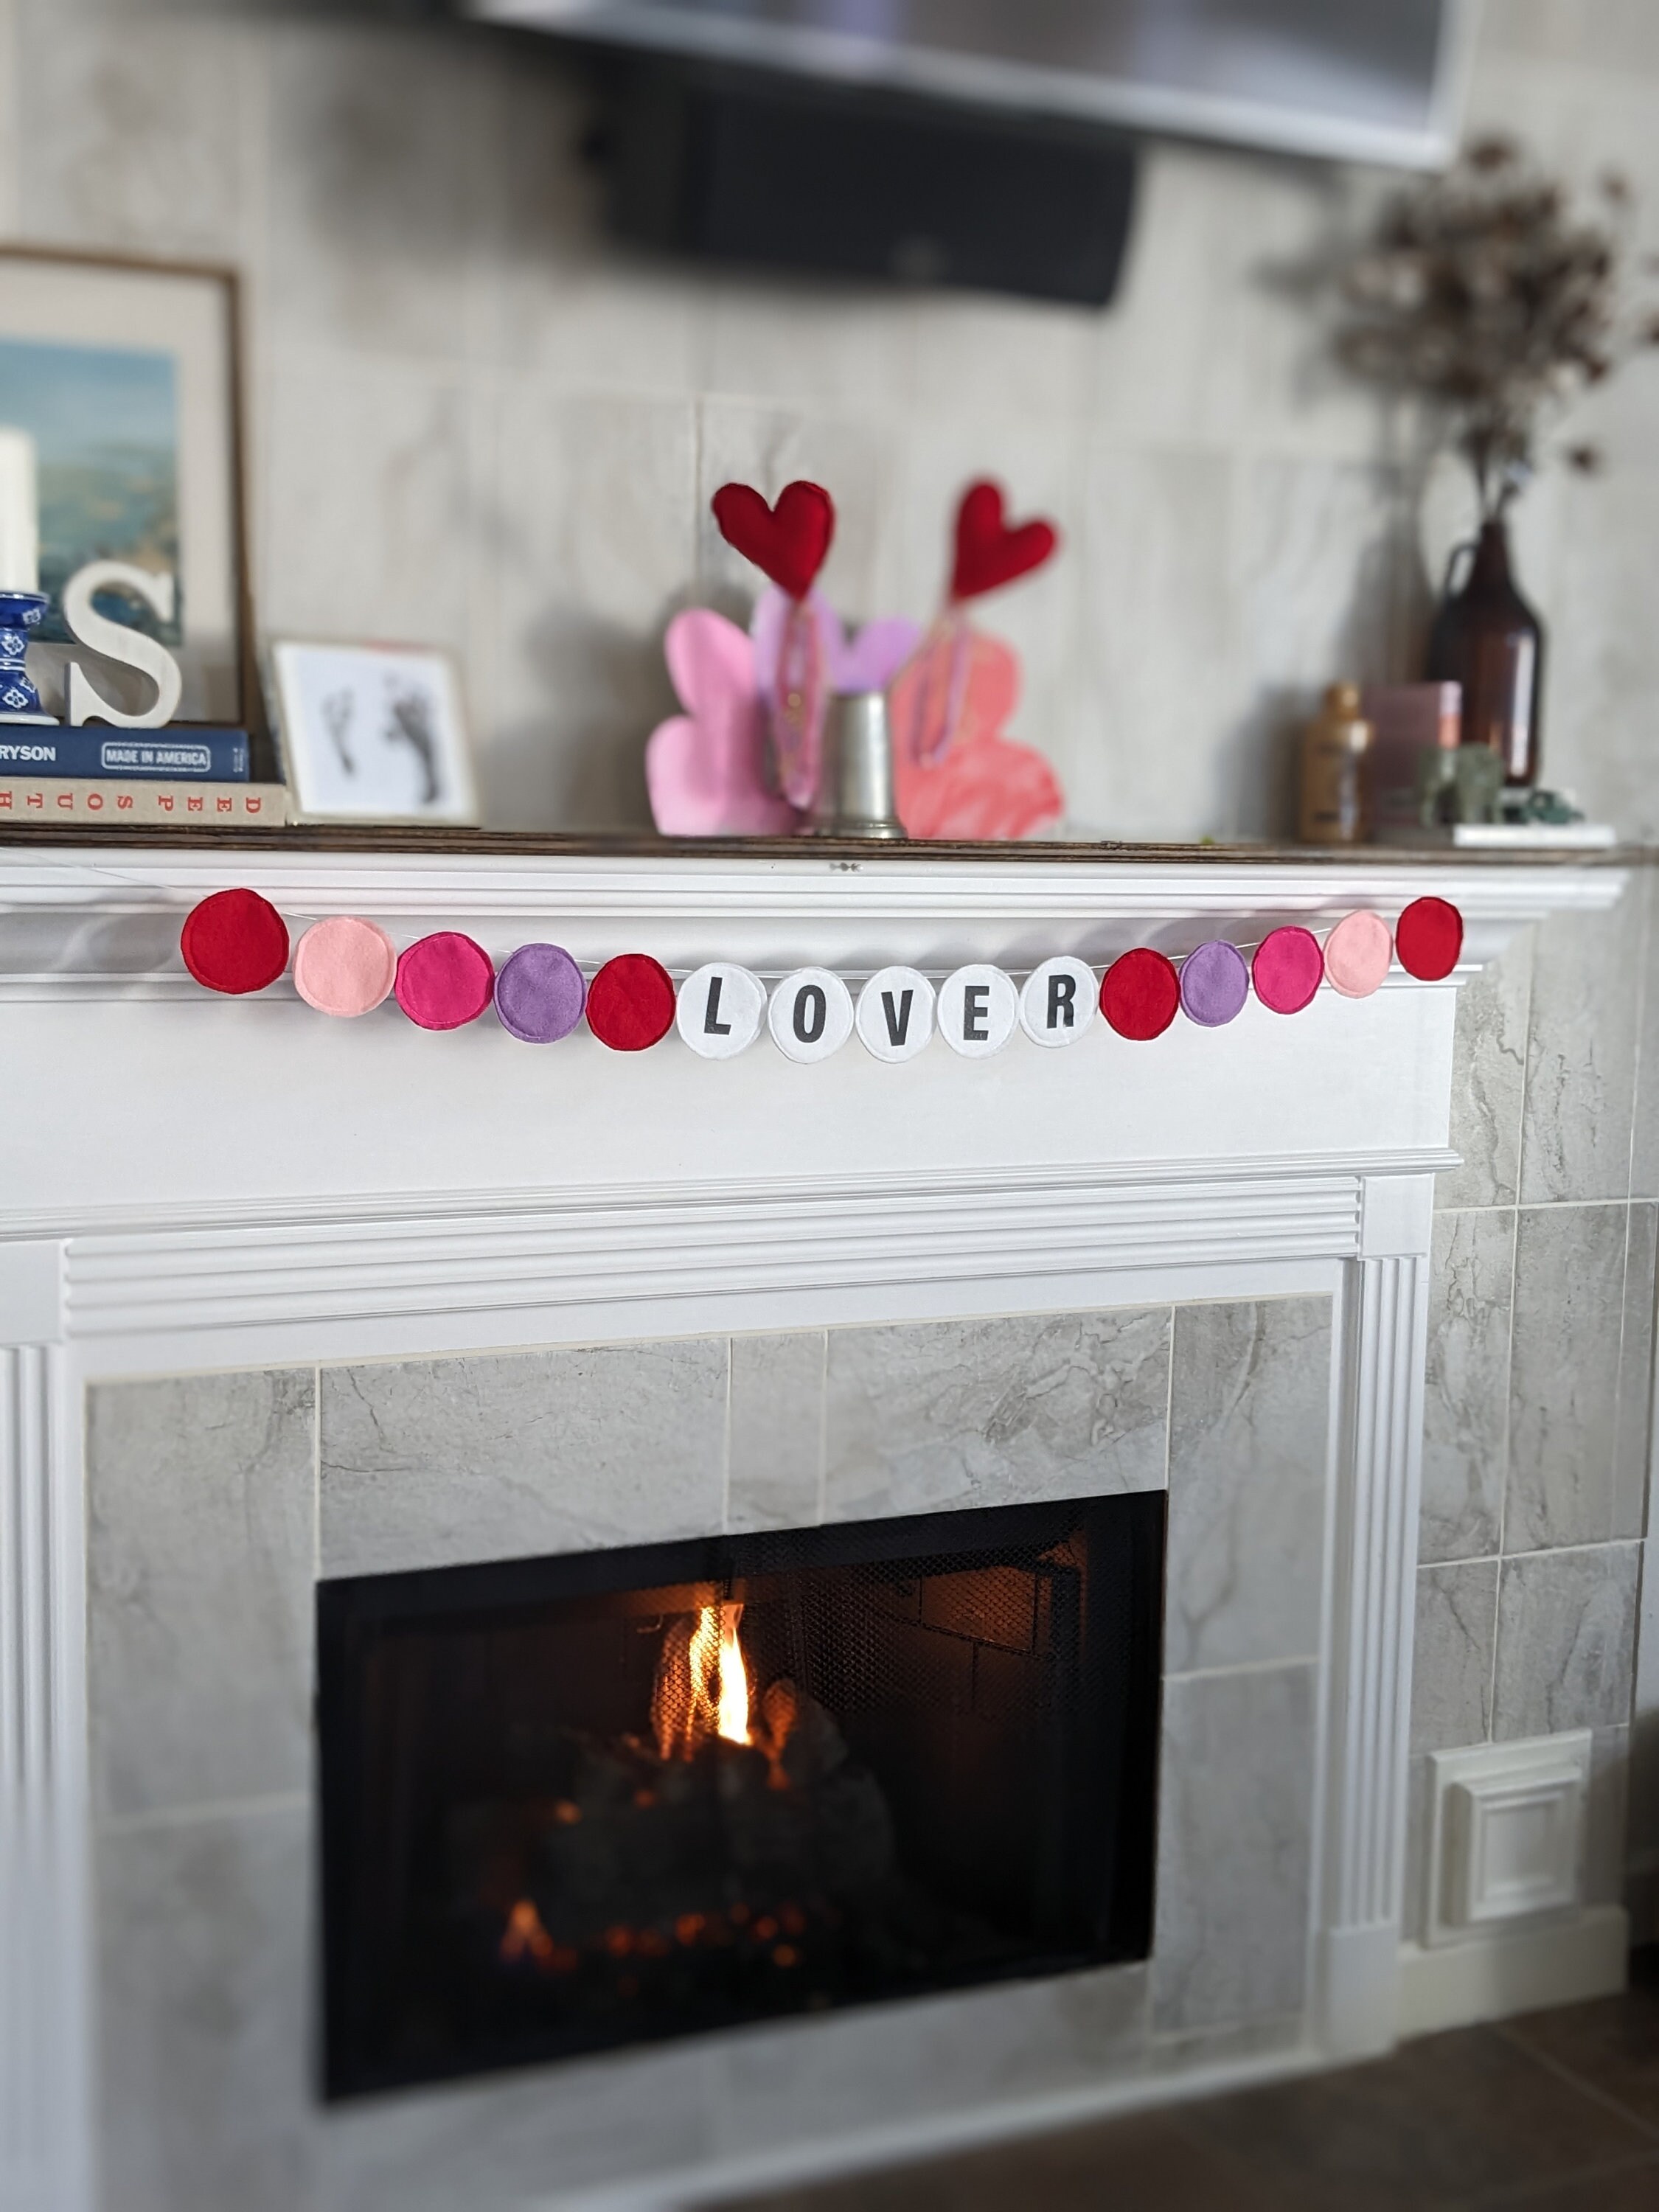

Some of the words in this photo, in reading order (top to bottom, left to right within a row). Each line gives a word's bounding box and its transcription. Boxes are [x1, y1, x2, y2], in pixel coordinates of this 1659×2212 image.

[63, 560, 181, 728] S
[106, 749, 139, 762] MADE
[141, 751, 153, 762] IN
[156, 751, 206, 765] AMERICA
[0, 791, 133, 810] SOUTH
[158, 795, 261, 813] DEEP
[703, 973, 1076, 1046] LOVER
